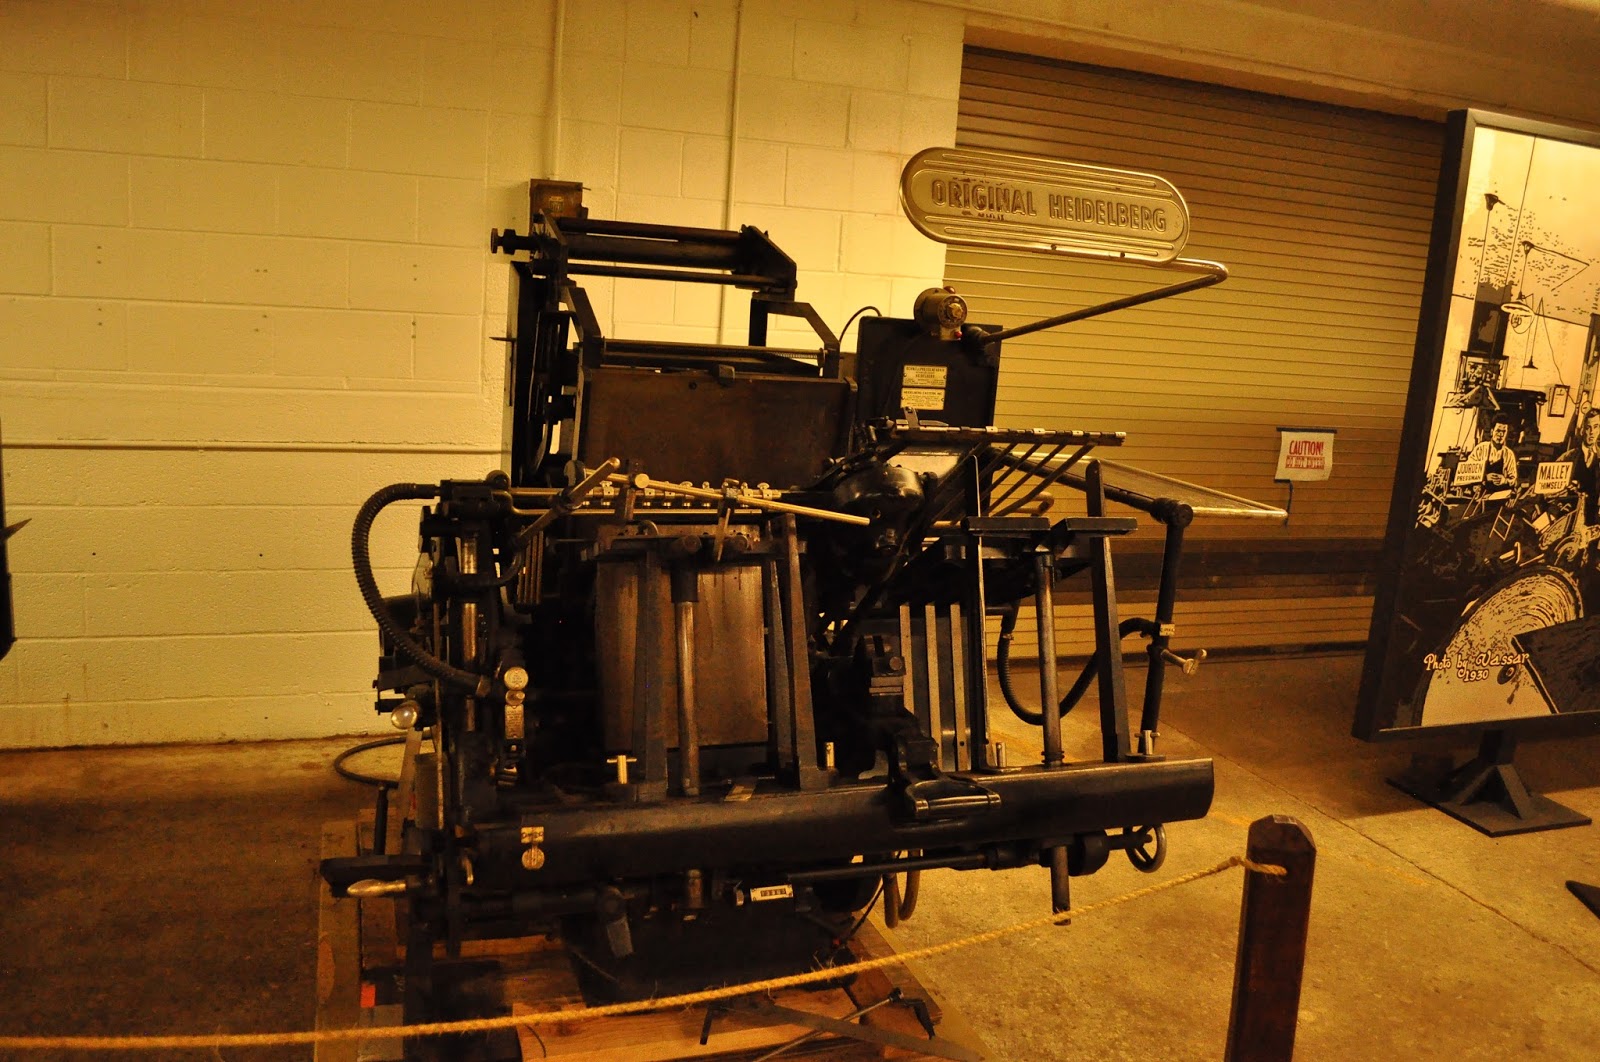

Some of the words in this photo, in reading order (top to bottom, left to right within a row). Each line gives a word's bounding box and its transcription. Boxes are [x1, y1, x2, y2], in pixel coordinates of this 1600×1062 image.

[931, 179, 1037, 217] ORIGINAL
[1048, 193, 1167, 233] HEIDELBERG
[1539, 465, 1570, 480] MALLEY
[1423, 653, 1452, 671] Photo
[1456, 653, 1469, 678] by
[1464, 669, 1490, 683] 1930
